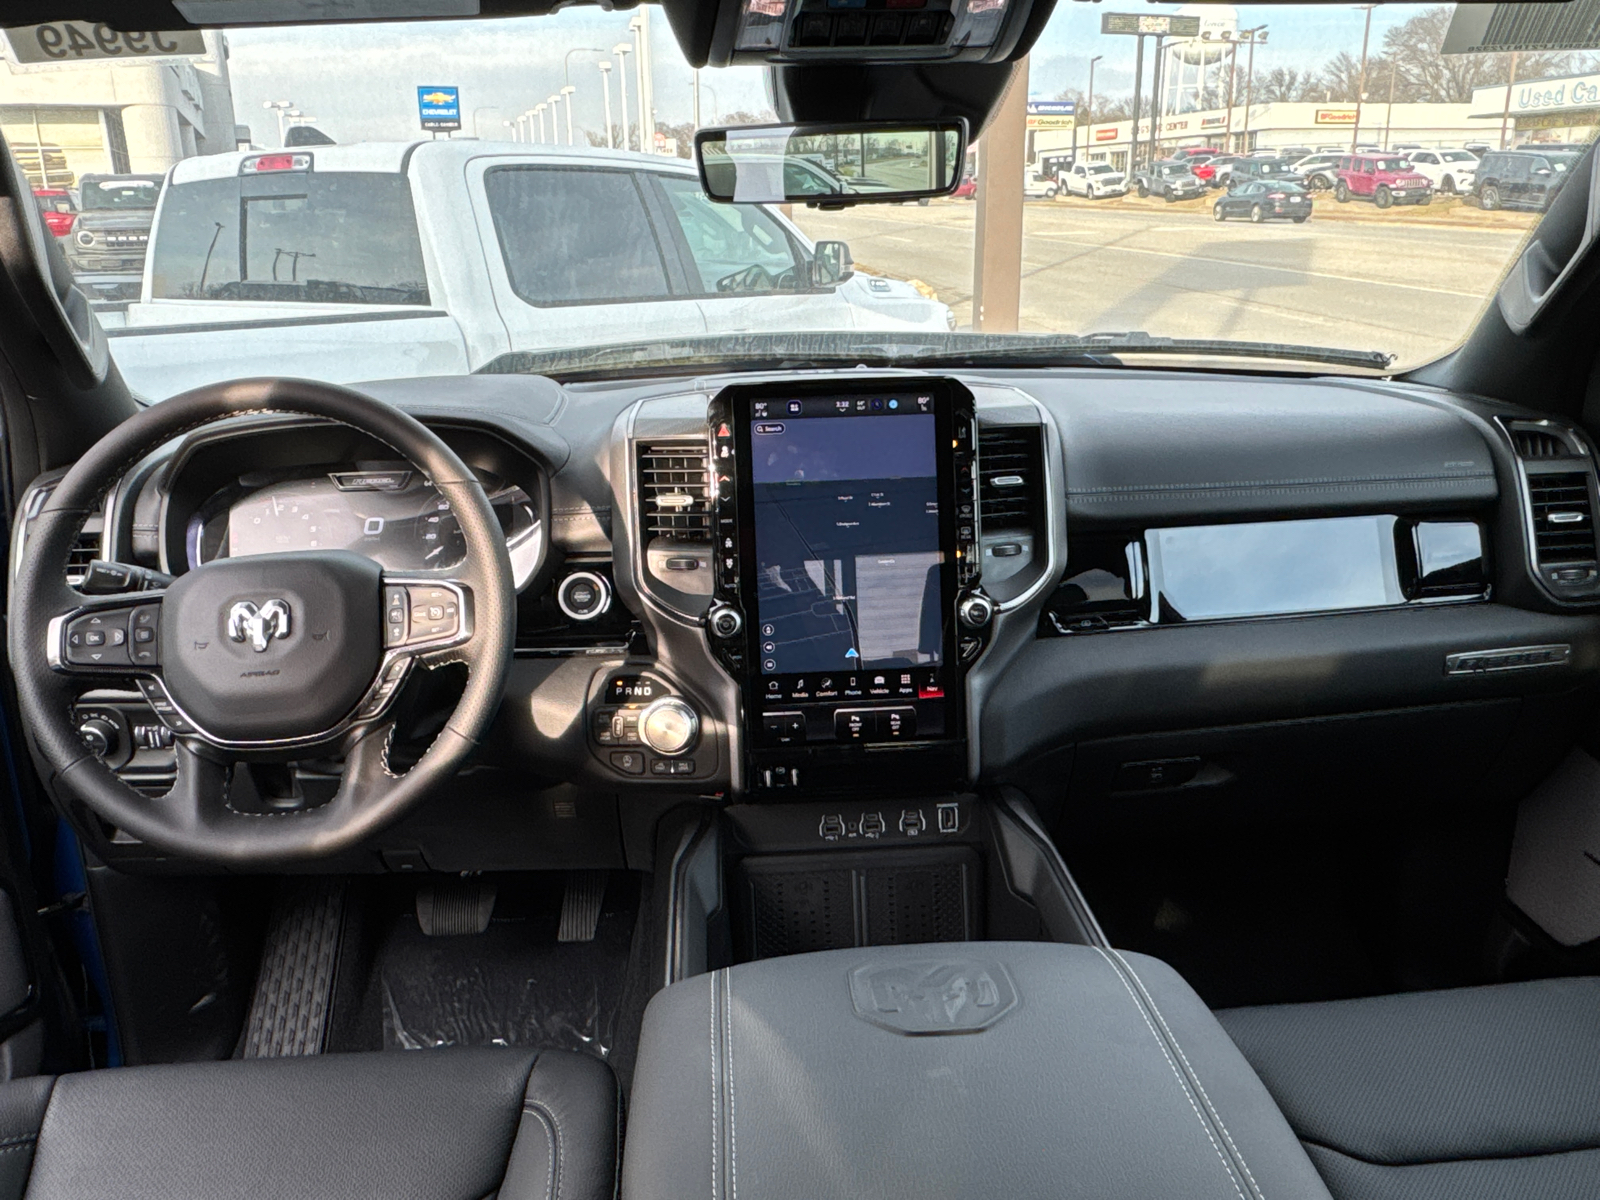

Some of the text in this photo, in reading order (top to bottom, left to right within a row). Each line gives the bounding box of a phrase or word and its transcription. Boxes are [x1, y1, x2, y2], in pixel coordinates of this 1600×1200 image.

[1518, 84, 1566, 109] Used
[1166, 121, 1189, 132] CENTER
[363, 517, 385, 535] 0
